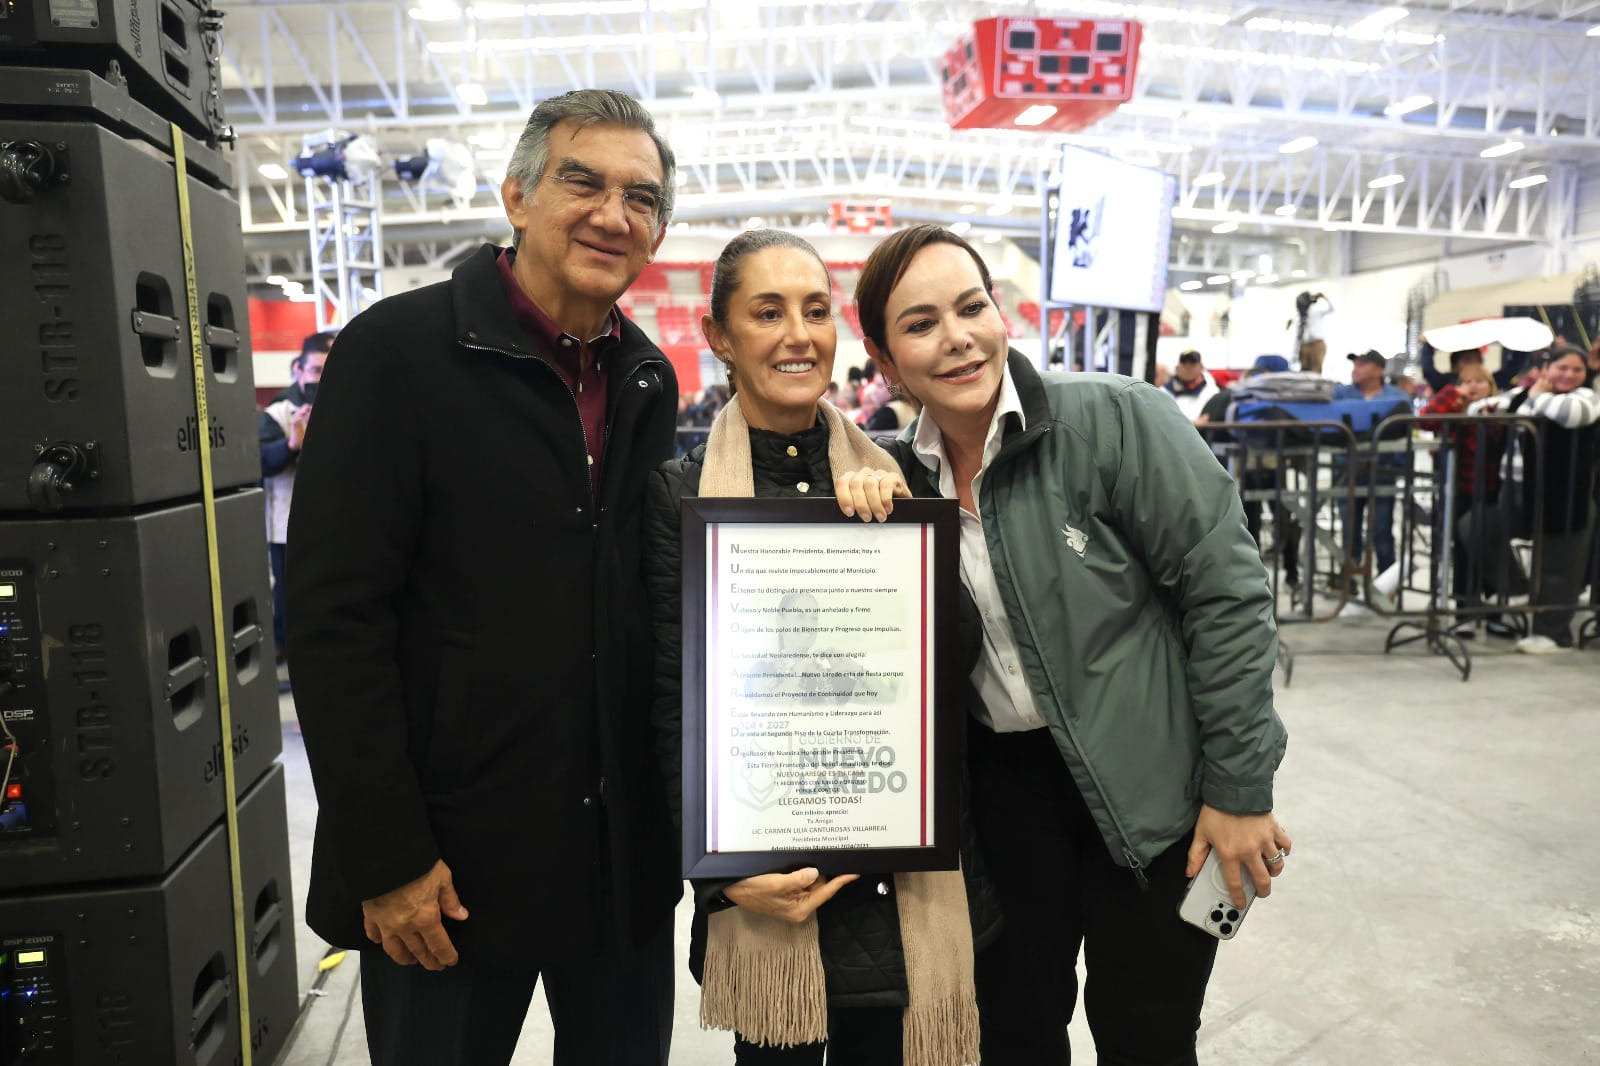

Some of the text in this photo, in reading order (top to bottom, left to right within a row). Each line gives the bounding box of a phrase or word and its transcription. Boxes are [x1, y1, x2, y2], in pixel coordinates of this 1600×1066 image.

[177, 415, 226, 454] elisis
[731, 544, 758, 554] Nuestra
[731, 564, 744, 574] Un
[4, 710, 34, 718] DSP
[767, 720, 790, 729] 2027
[799, 734, 880, 745] GOBIERNO DE
[204, 726, 250, 784] elisis
[799, 746, 896, 769] NUEVO
[799, 770, 908, 794] LAREDO
[779, 796, 862, 805] LLEGAMOS TODAS!
[24, 936, 54, 944] 2000
